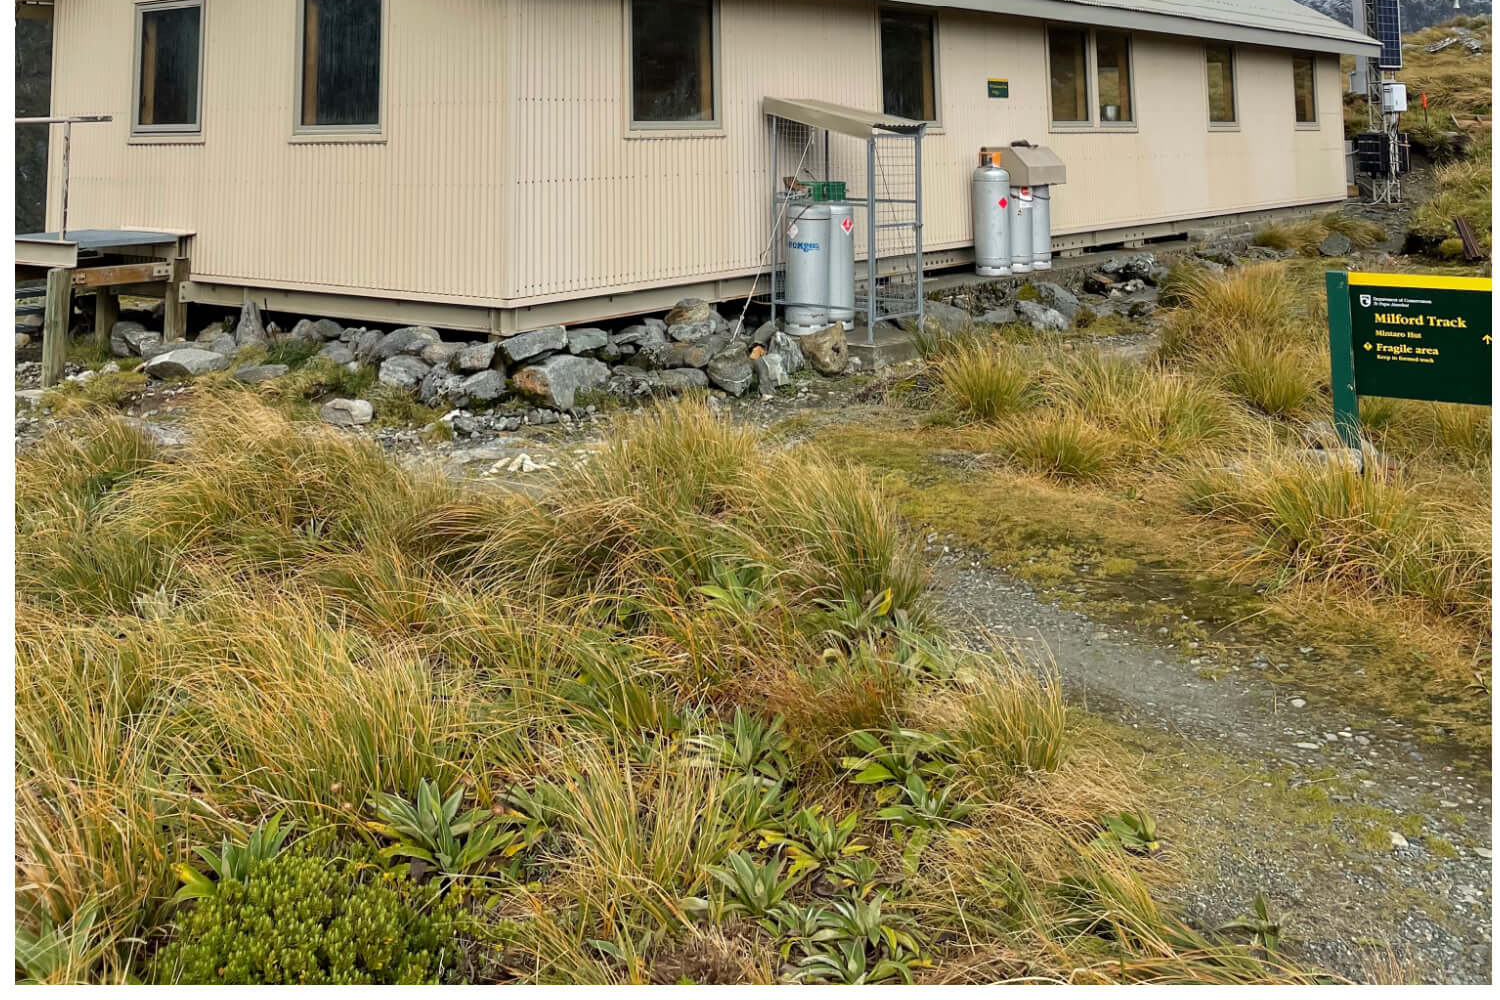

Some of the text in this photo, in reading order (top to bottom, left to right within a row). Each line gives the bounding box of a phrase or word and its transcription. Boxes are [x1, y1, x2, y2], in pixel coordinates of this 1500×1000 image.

[1374, 313, 1467, 328] Milford Track
[1376, 343, 1440, 356] Fragile area
